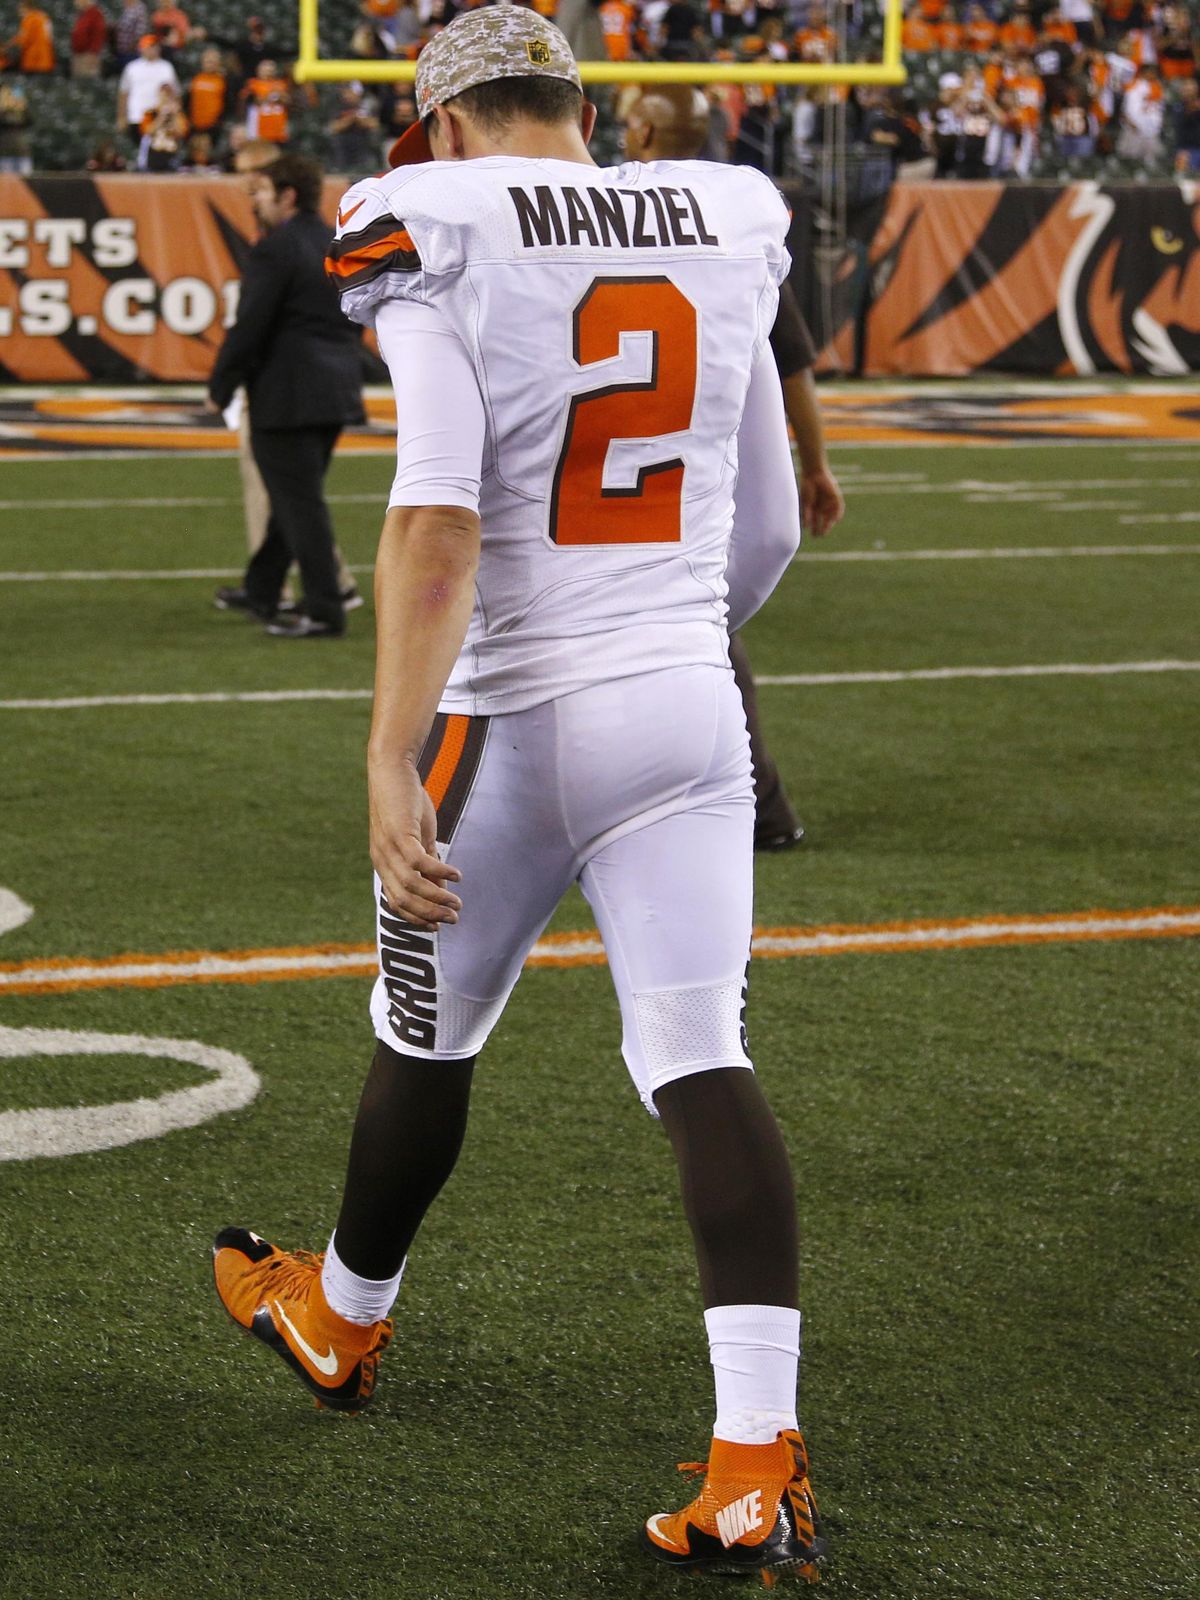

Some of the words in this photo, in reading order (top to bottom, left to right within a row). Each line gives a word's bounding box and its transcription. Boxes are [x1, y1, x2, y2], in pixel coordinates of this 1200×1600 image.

[507, 186, 718, 248] MANZIEL
[548, 274, 698, 546] 2
[379, 882, 438, 1051] BROW
[715, 1489, 764, 1549] NIKE
